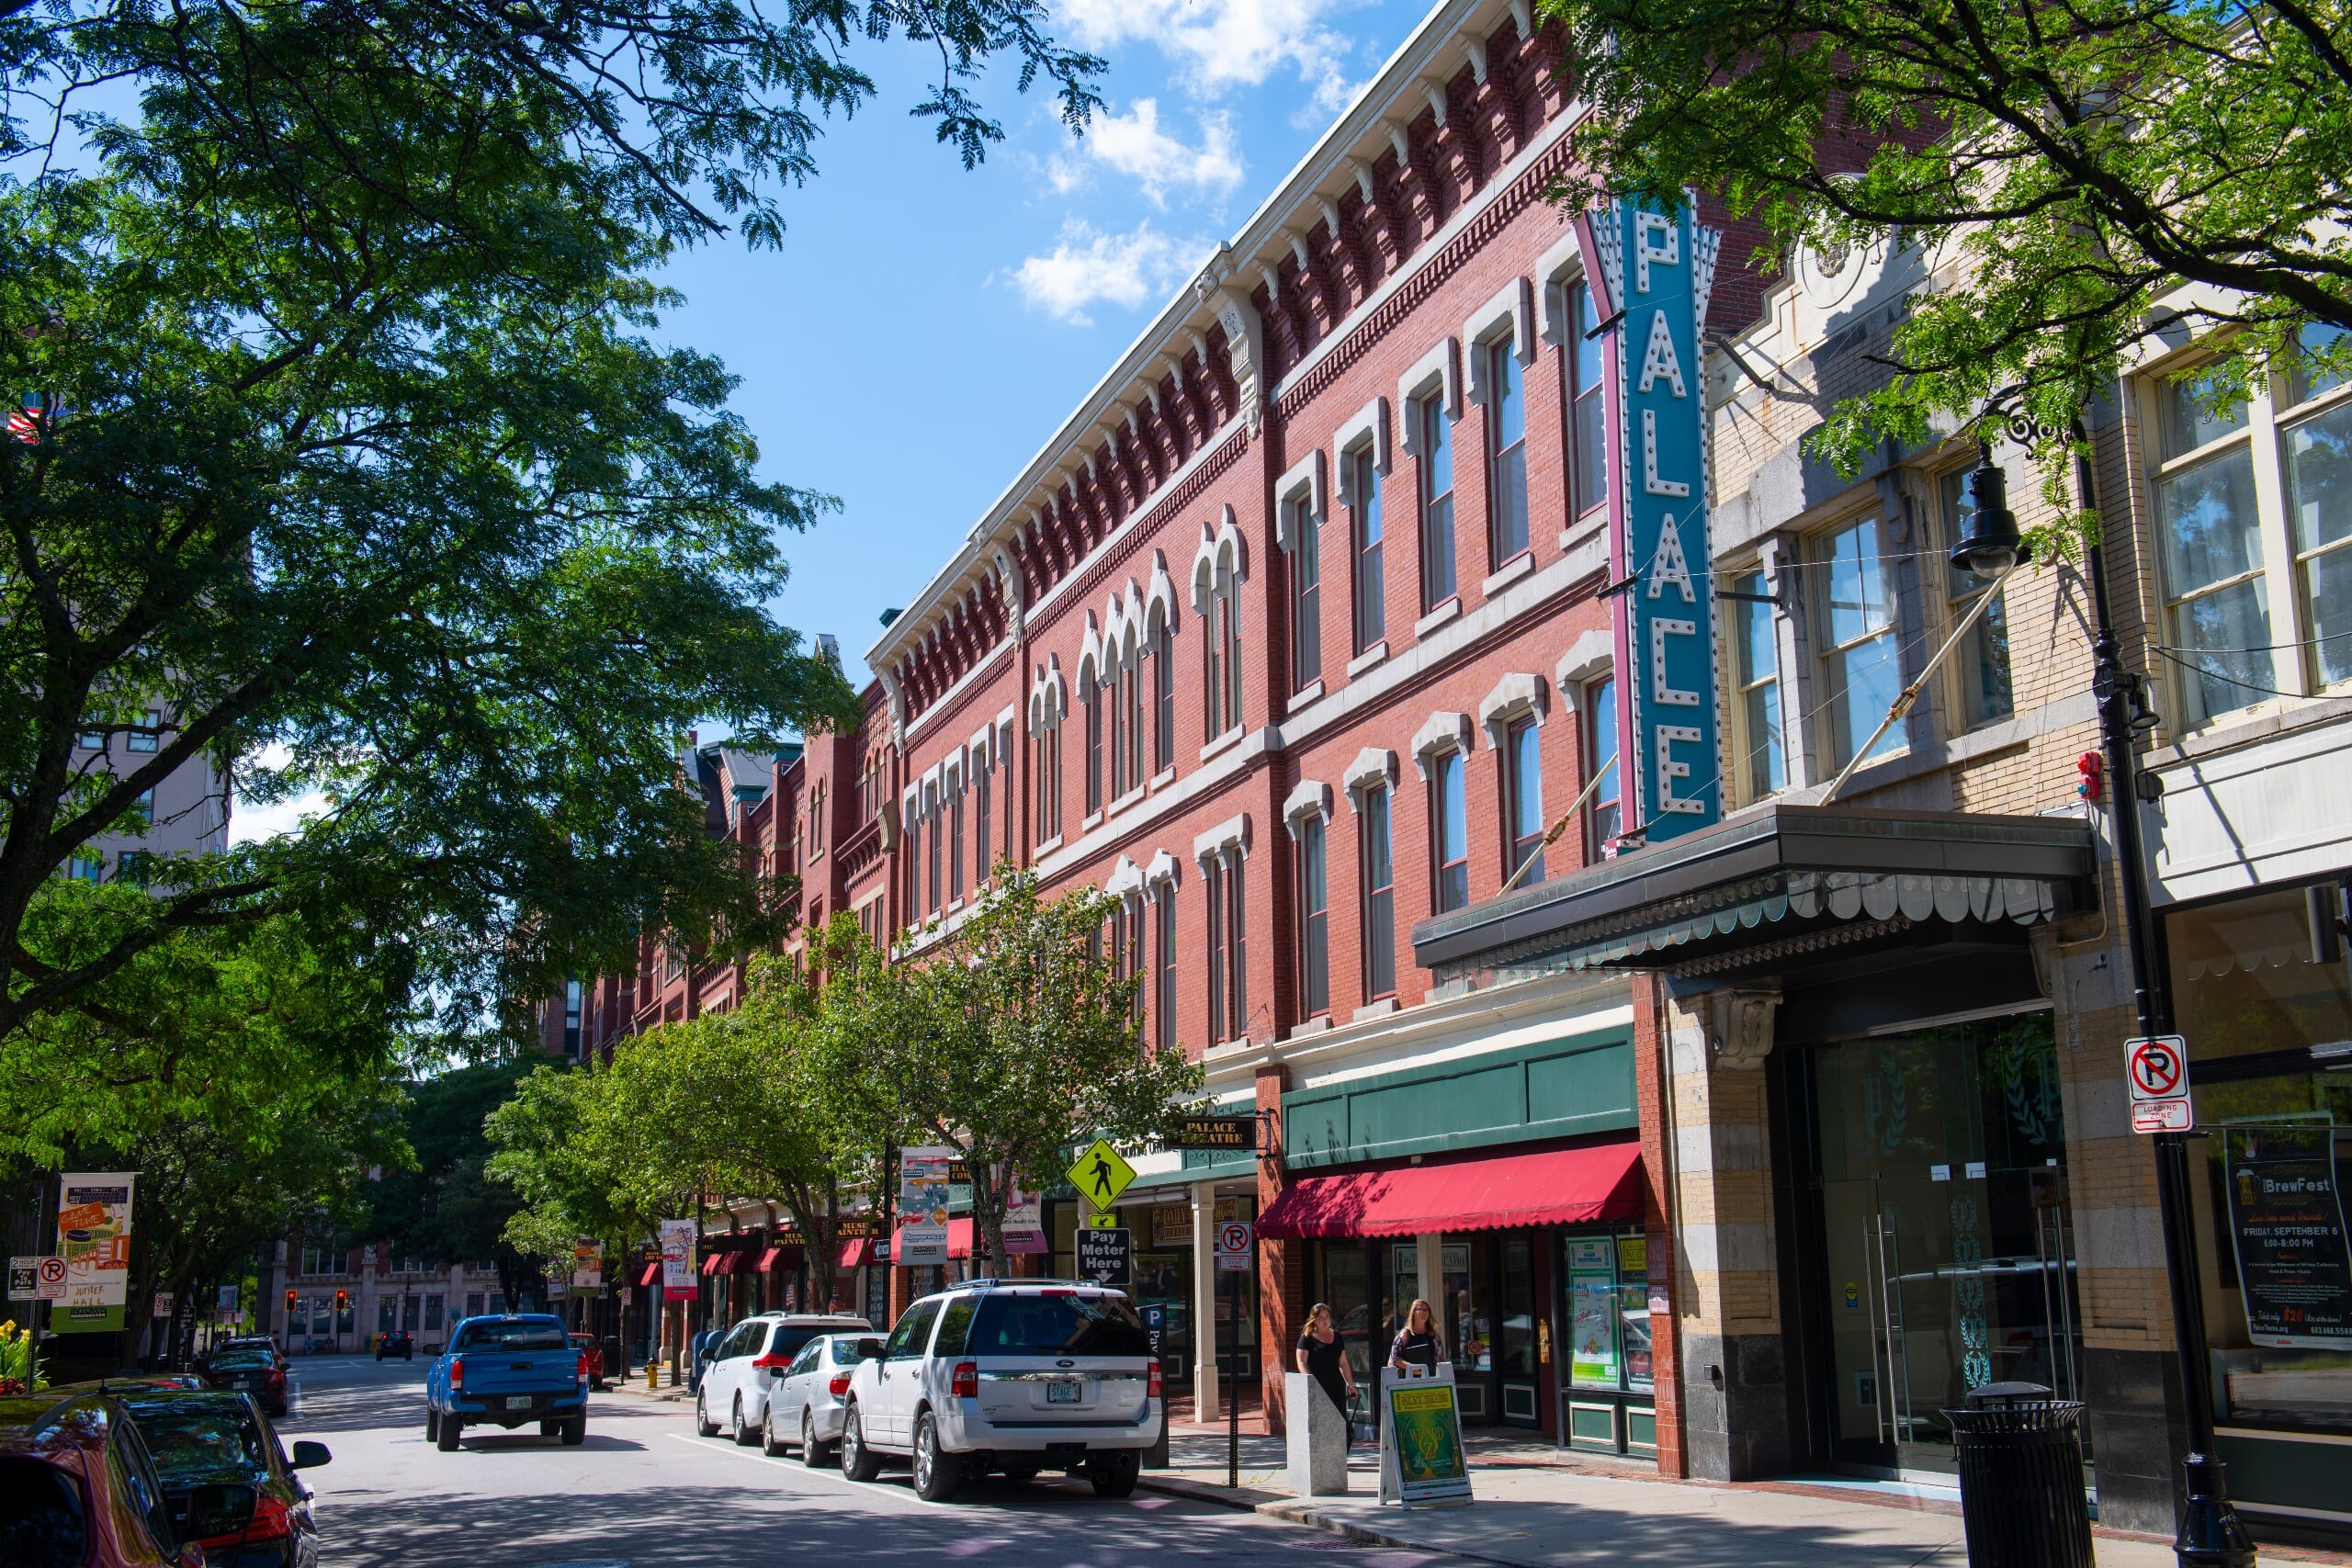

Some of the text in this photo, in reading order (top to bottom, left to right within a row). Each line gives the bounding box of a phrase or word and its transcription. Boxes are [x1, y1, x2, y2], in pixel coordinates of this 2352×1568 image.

[1633, 211, 1704, 815] PALACE
[1186, 1122, 1236, 1133] PALACE
[2266, 1178, 2330, 1192] BrewFest
[61, 1206, 92, 1224] GAME
[74, 1213, 100, 1228] TIME
[2244, 1228, 2273, 1236] FRIDAY,
[2274, 1227, 2329, 1235] SEPTEMBER
[1090, 1231, 1117, 1245] Pay
[2264, 1239, 2313, 1247] 6:00-8:00 PM
[1081, 1245, 1125, 1256] Meter
[12, 1259, 18, 1268] 2
[1086, 1258, 1122, 1269] Here
[75, 1286, 105, 1296] JUPITER
[74, 1297, 105, 1306] HALL
[1149, 1310, 1160, 1325] P
[2283, 1308, 2303, 1323] $20
[1051, 1387, 1072, 1397] STAGE
